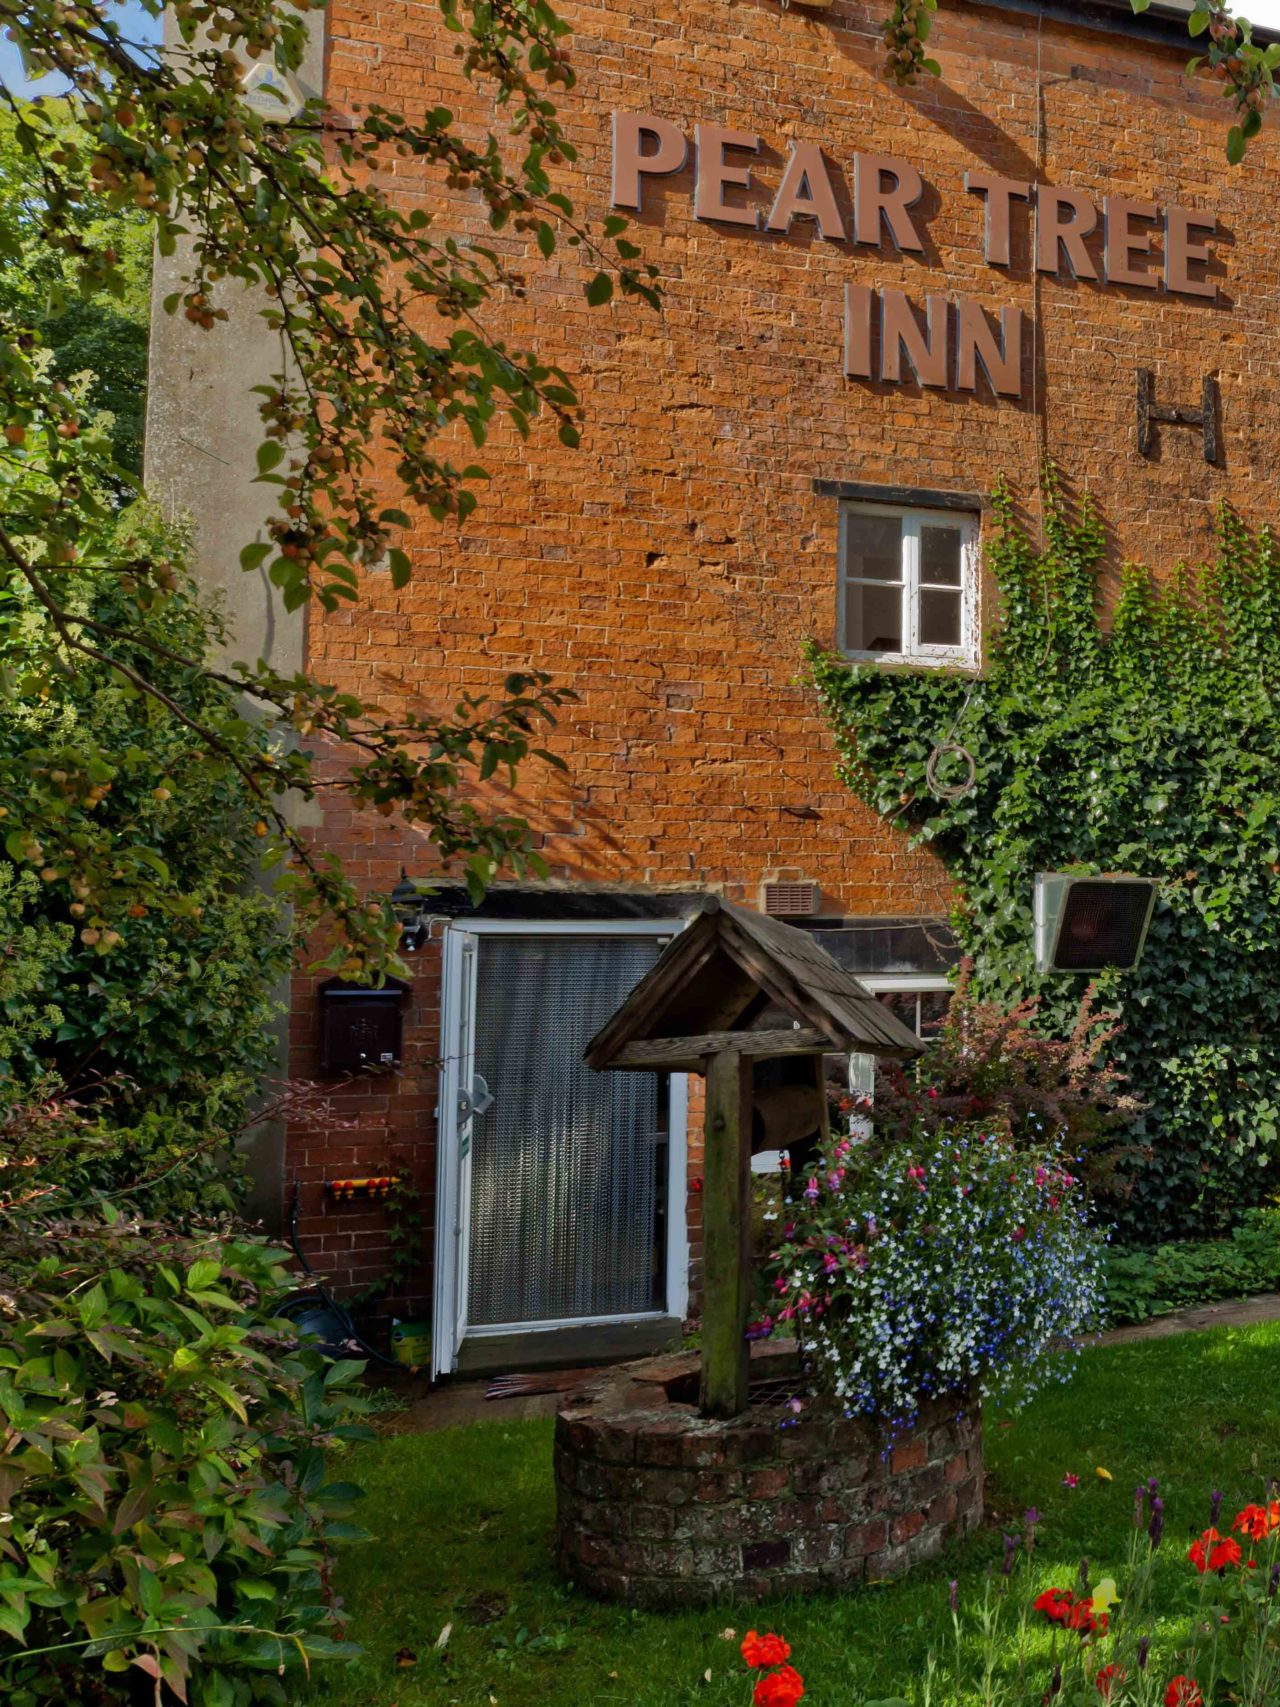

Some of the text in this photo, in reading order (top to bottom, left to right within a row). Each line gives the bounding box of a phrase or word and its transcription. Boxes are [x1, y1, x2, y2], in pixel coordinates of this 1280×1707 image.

[611, 110, 1217, 299] PEAR TREE
[844, 282, 1023, 399] INN
